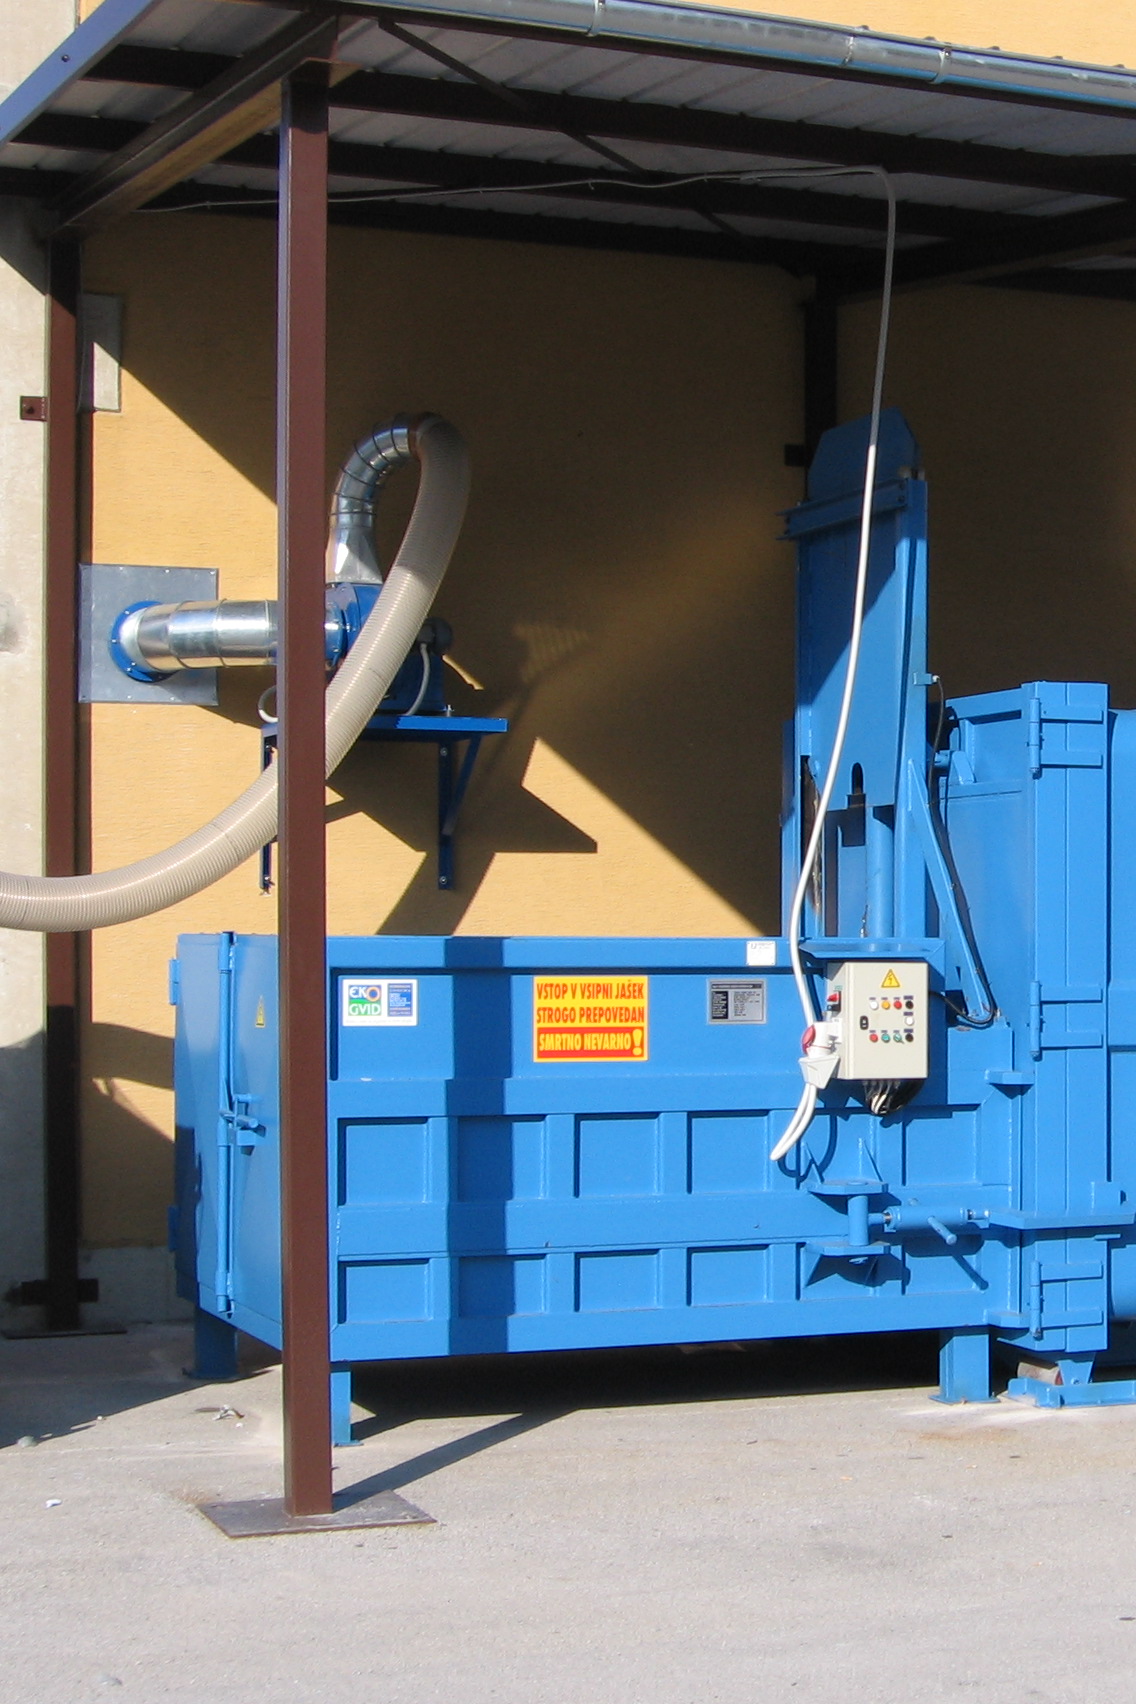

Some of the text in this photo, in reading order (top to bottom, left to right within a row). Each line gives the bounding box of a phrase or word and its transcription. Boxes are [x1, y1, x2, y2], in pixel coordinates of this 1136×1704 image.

[537, 980, 644, 999] VSTOP V VSIPNI JAŠEK
[349, 1004, 381, 1015] GVID
[537, 1007, 645, 1023] STROGO PREPOVEDAN
[539, 1034, 582, 1051] SMRTNO
